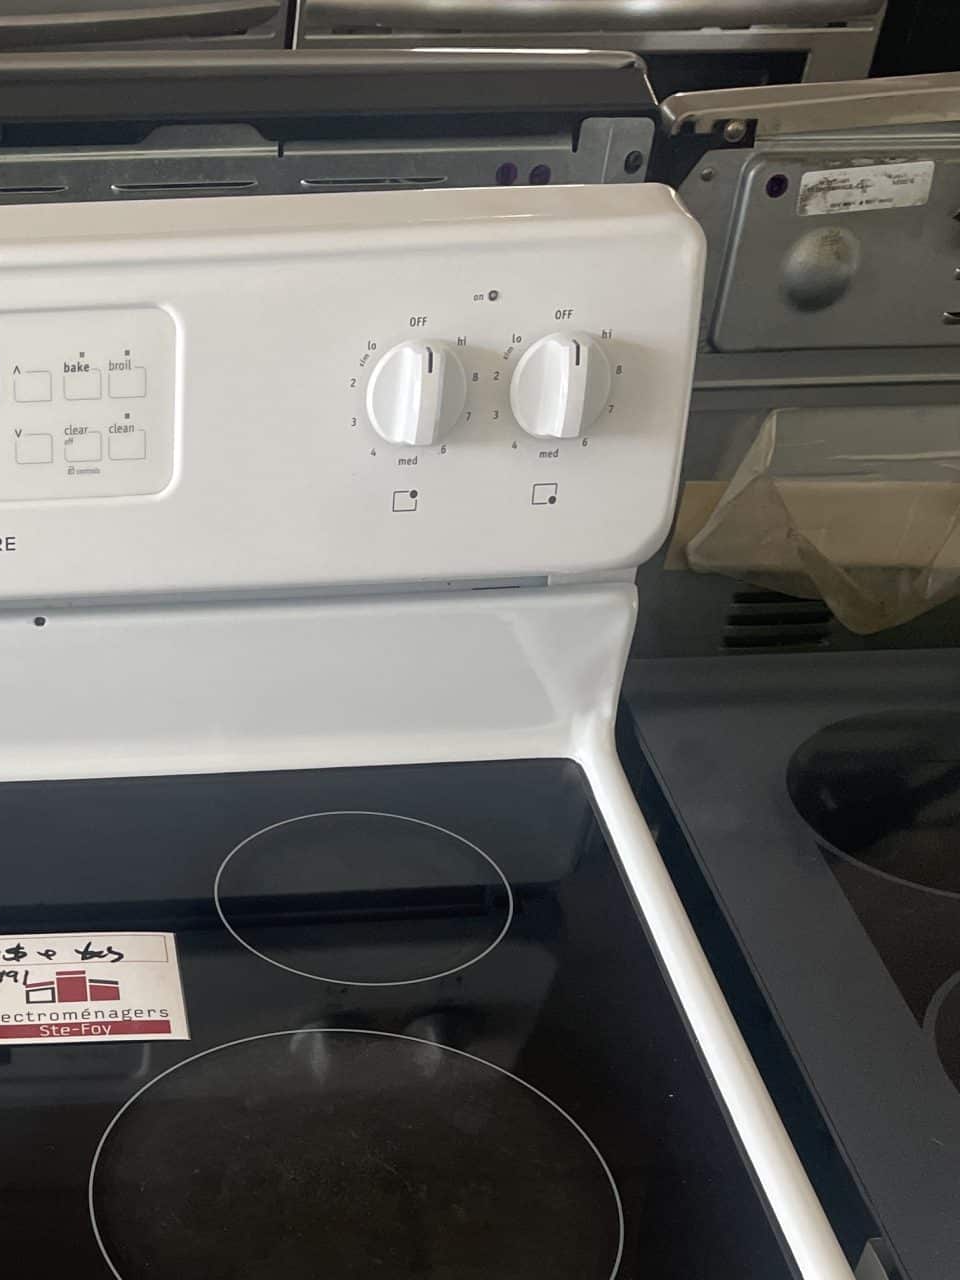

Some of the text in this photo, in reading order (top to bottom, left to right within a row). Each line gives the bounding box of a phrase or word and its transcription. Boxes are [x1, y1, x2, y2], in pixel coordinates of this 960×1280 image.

[555, 309, 574, 319] OFF
[410, 317, 427, 327] OFF
[512, 334, 522, 343] lo
[602, 329, 612, 339] hi
[367, 340, 377, 350] lo
[457, 336, 466, 346] hi
[63, 362, 90, 373] bake
[108, 360, 132, 371] broil
[493, 371, 500, 380] 2
[351, 378, 356, 387] 2
[608, 405, 614, 413] 7
[466, 412, 471, 421] 7
[493, 411, 499, 419] 3
[352, 417, 357, 426] 3
[64, 425, 88, 435] clear
[108, 423, 135, 434] clean
[582, 438, 588, 447] 6
[539, 449, 559, 458] med
[398, 456, 418, 466] med
[40, 1023, 112, 1037] Ste-Foy
